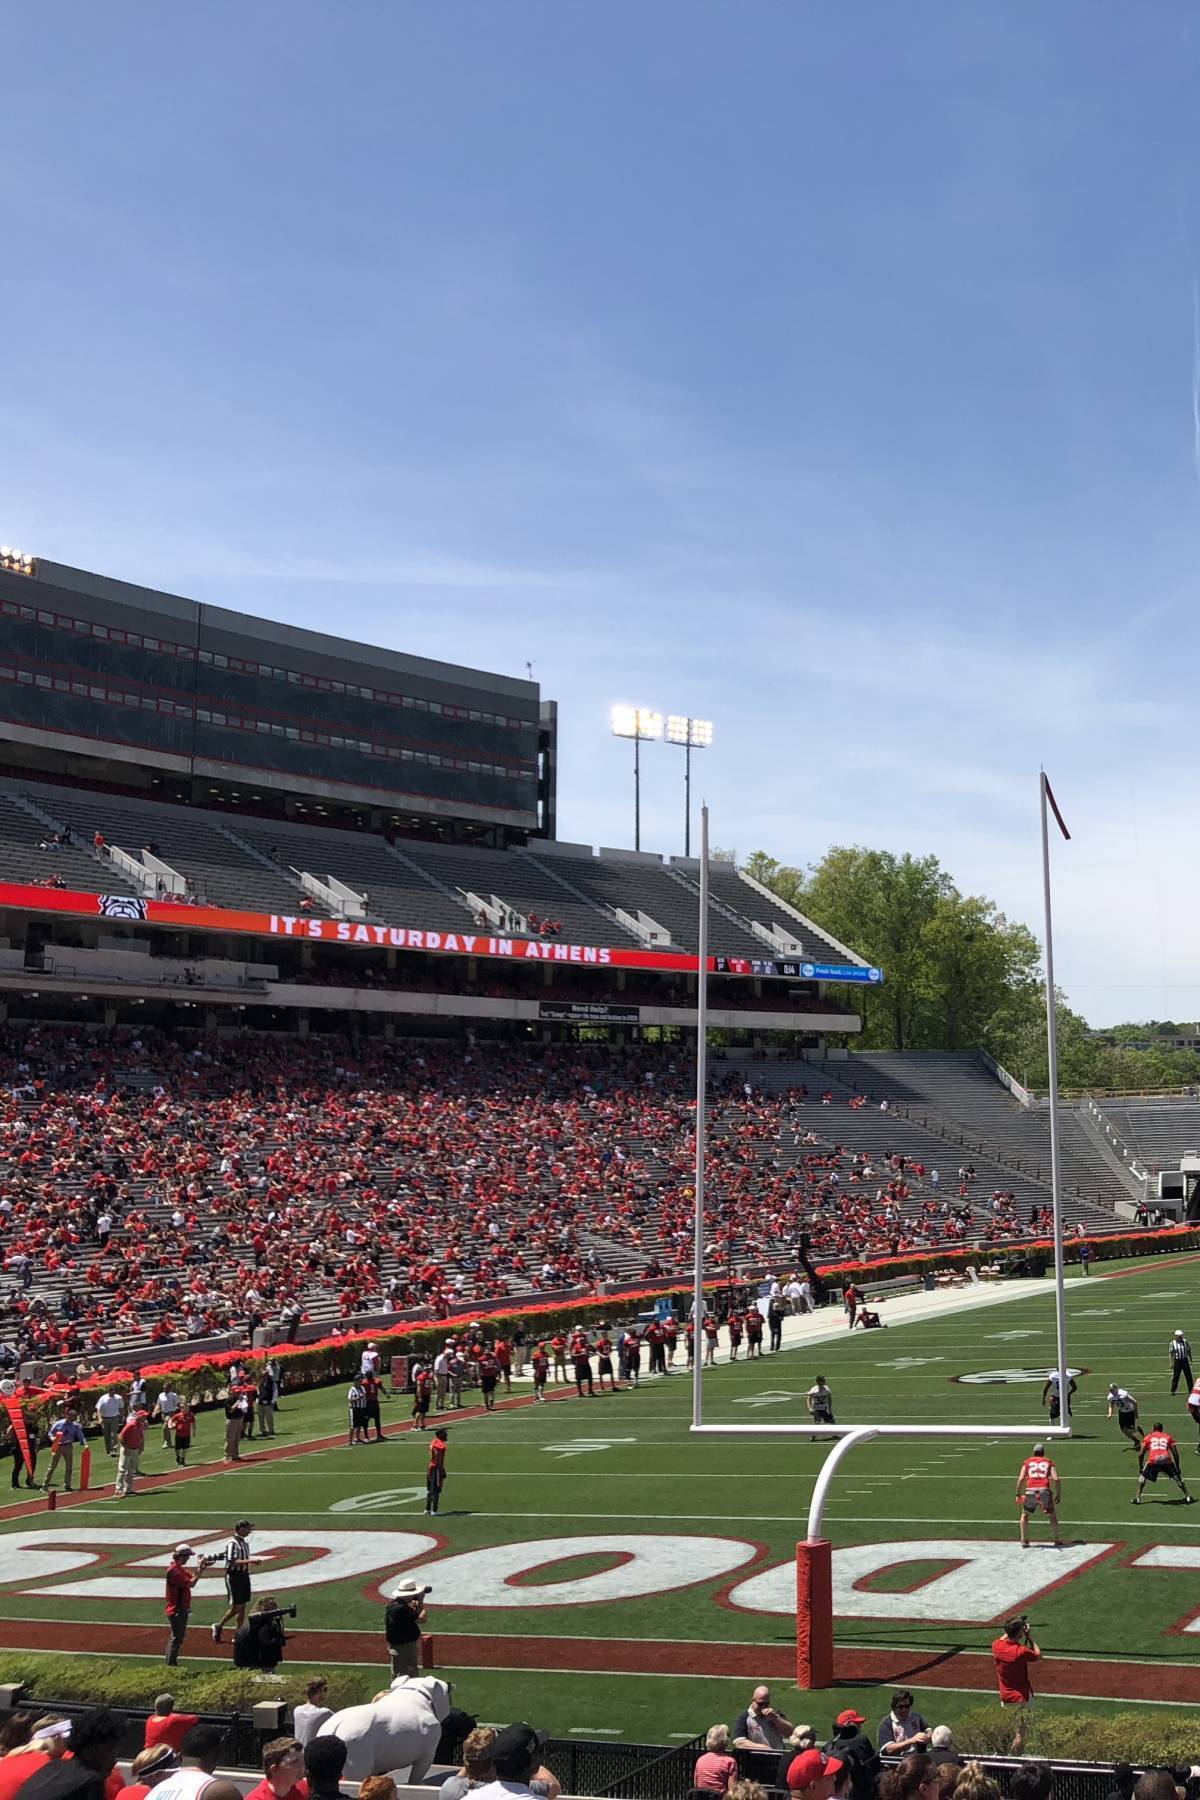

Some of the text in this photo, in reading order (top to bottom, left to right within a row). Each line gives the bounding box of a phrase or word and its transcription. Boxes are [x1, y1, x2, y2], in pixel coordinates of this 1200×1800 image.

[270, 915, 611, 964] IT'S SATURDAY IN ATHENS
